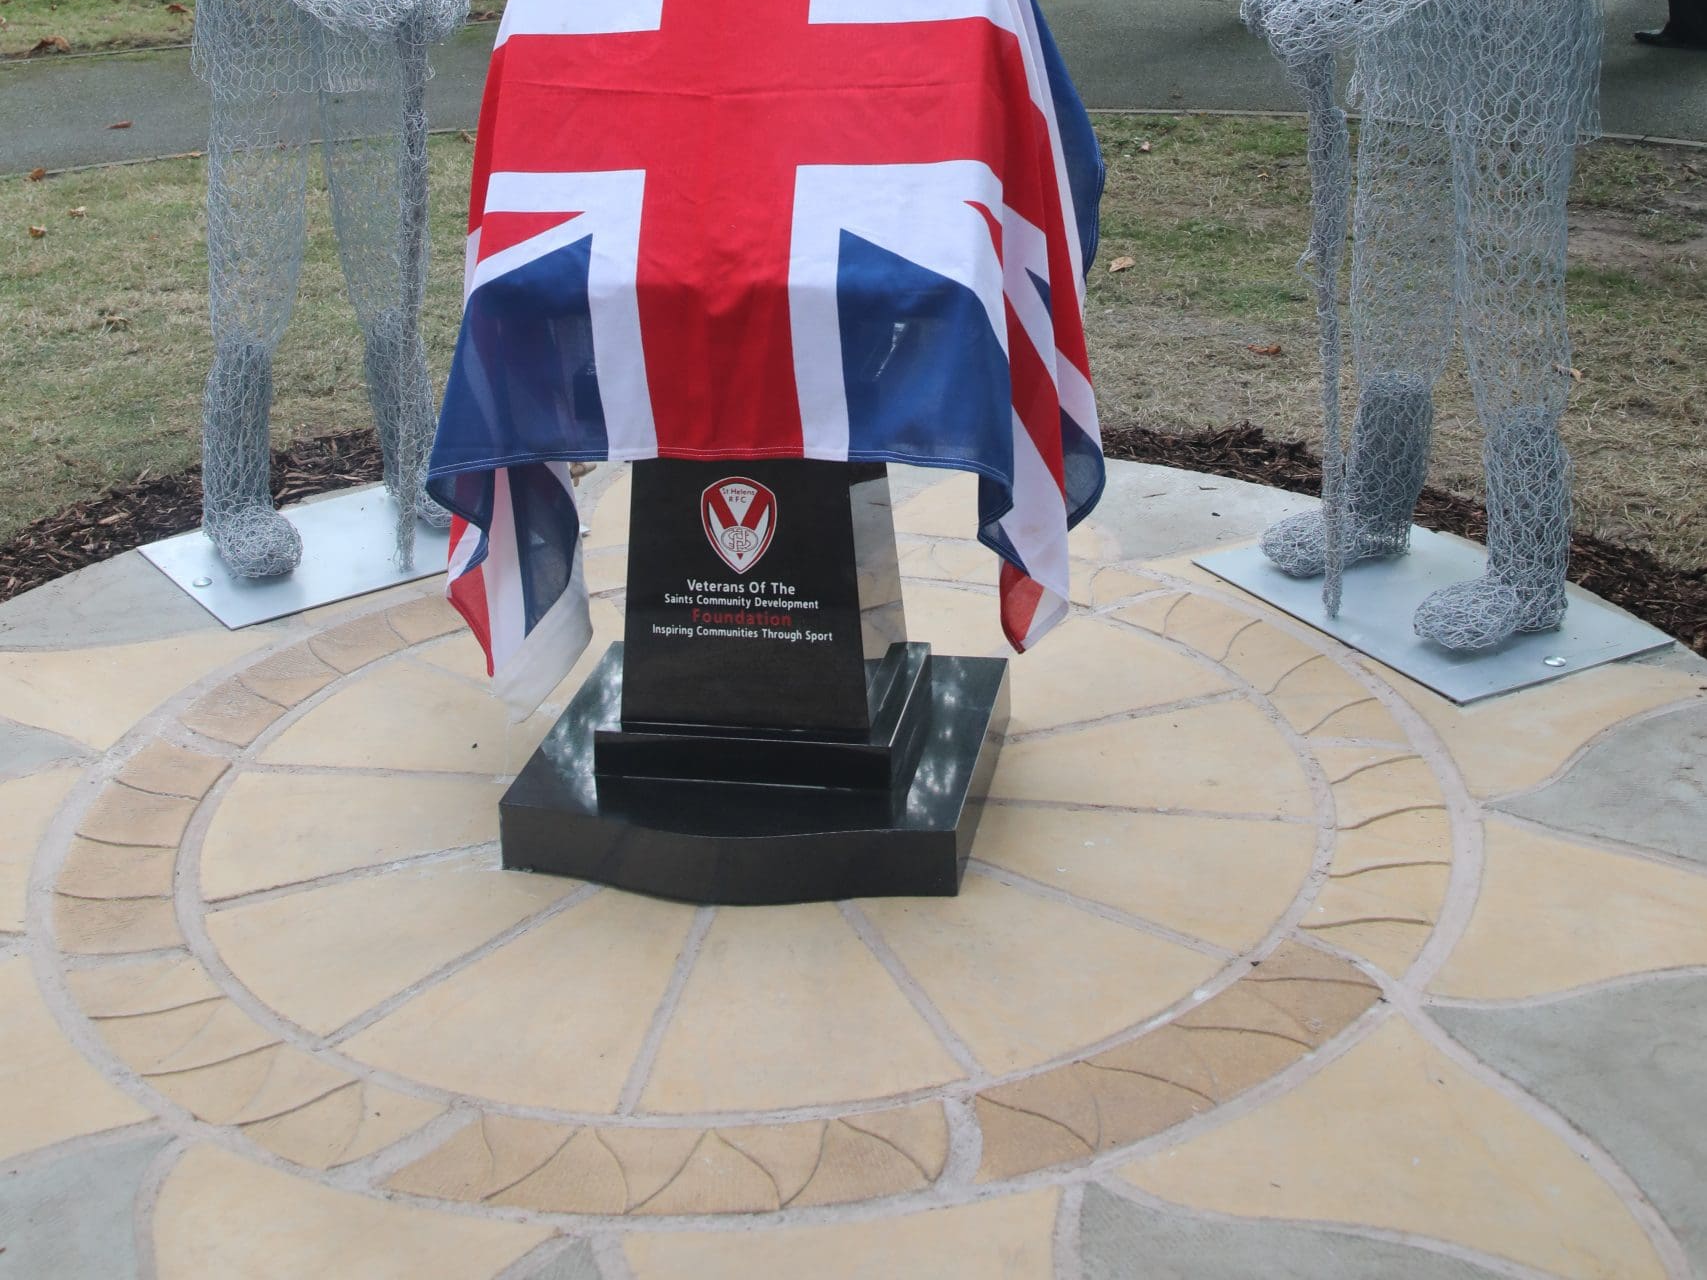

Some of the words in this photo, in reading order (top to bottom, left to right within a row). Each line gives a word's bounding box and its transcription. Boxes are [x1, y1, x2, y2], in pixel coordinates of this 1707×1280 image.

[731, 488, 755, 496] Helens
[687, 579, 744, 593] Veterans
[749, 582, 766, 594] Of
[771, 582, 796, 595] The
[664, 594, 693, 604] Saints
[697, 595, 751, 608] Community
[755, 597, 818, 609] Development
[692, 608, 792, 626] Foundation
[652, 624, 693, 637] Inspiring
[696, 626, 758, 638] Communities
[762, 628, 802, 642] Through
[805, 630, 832, 642] Sport
